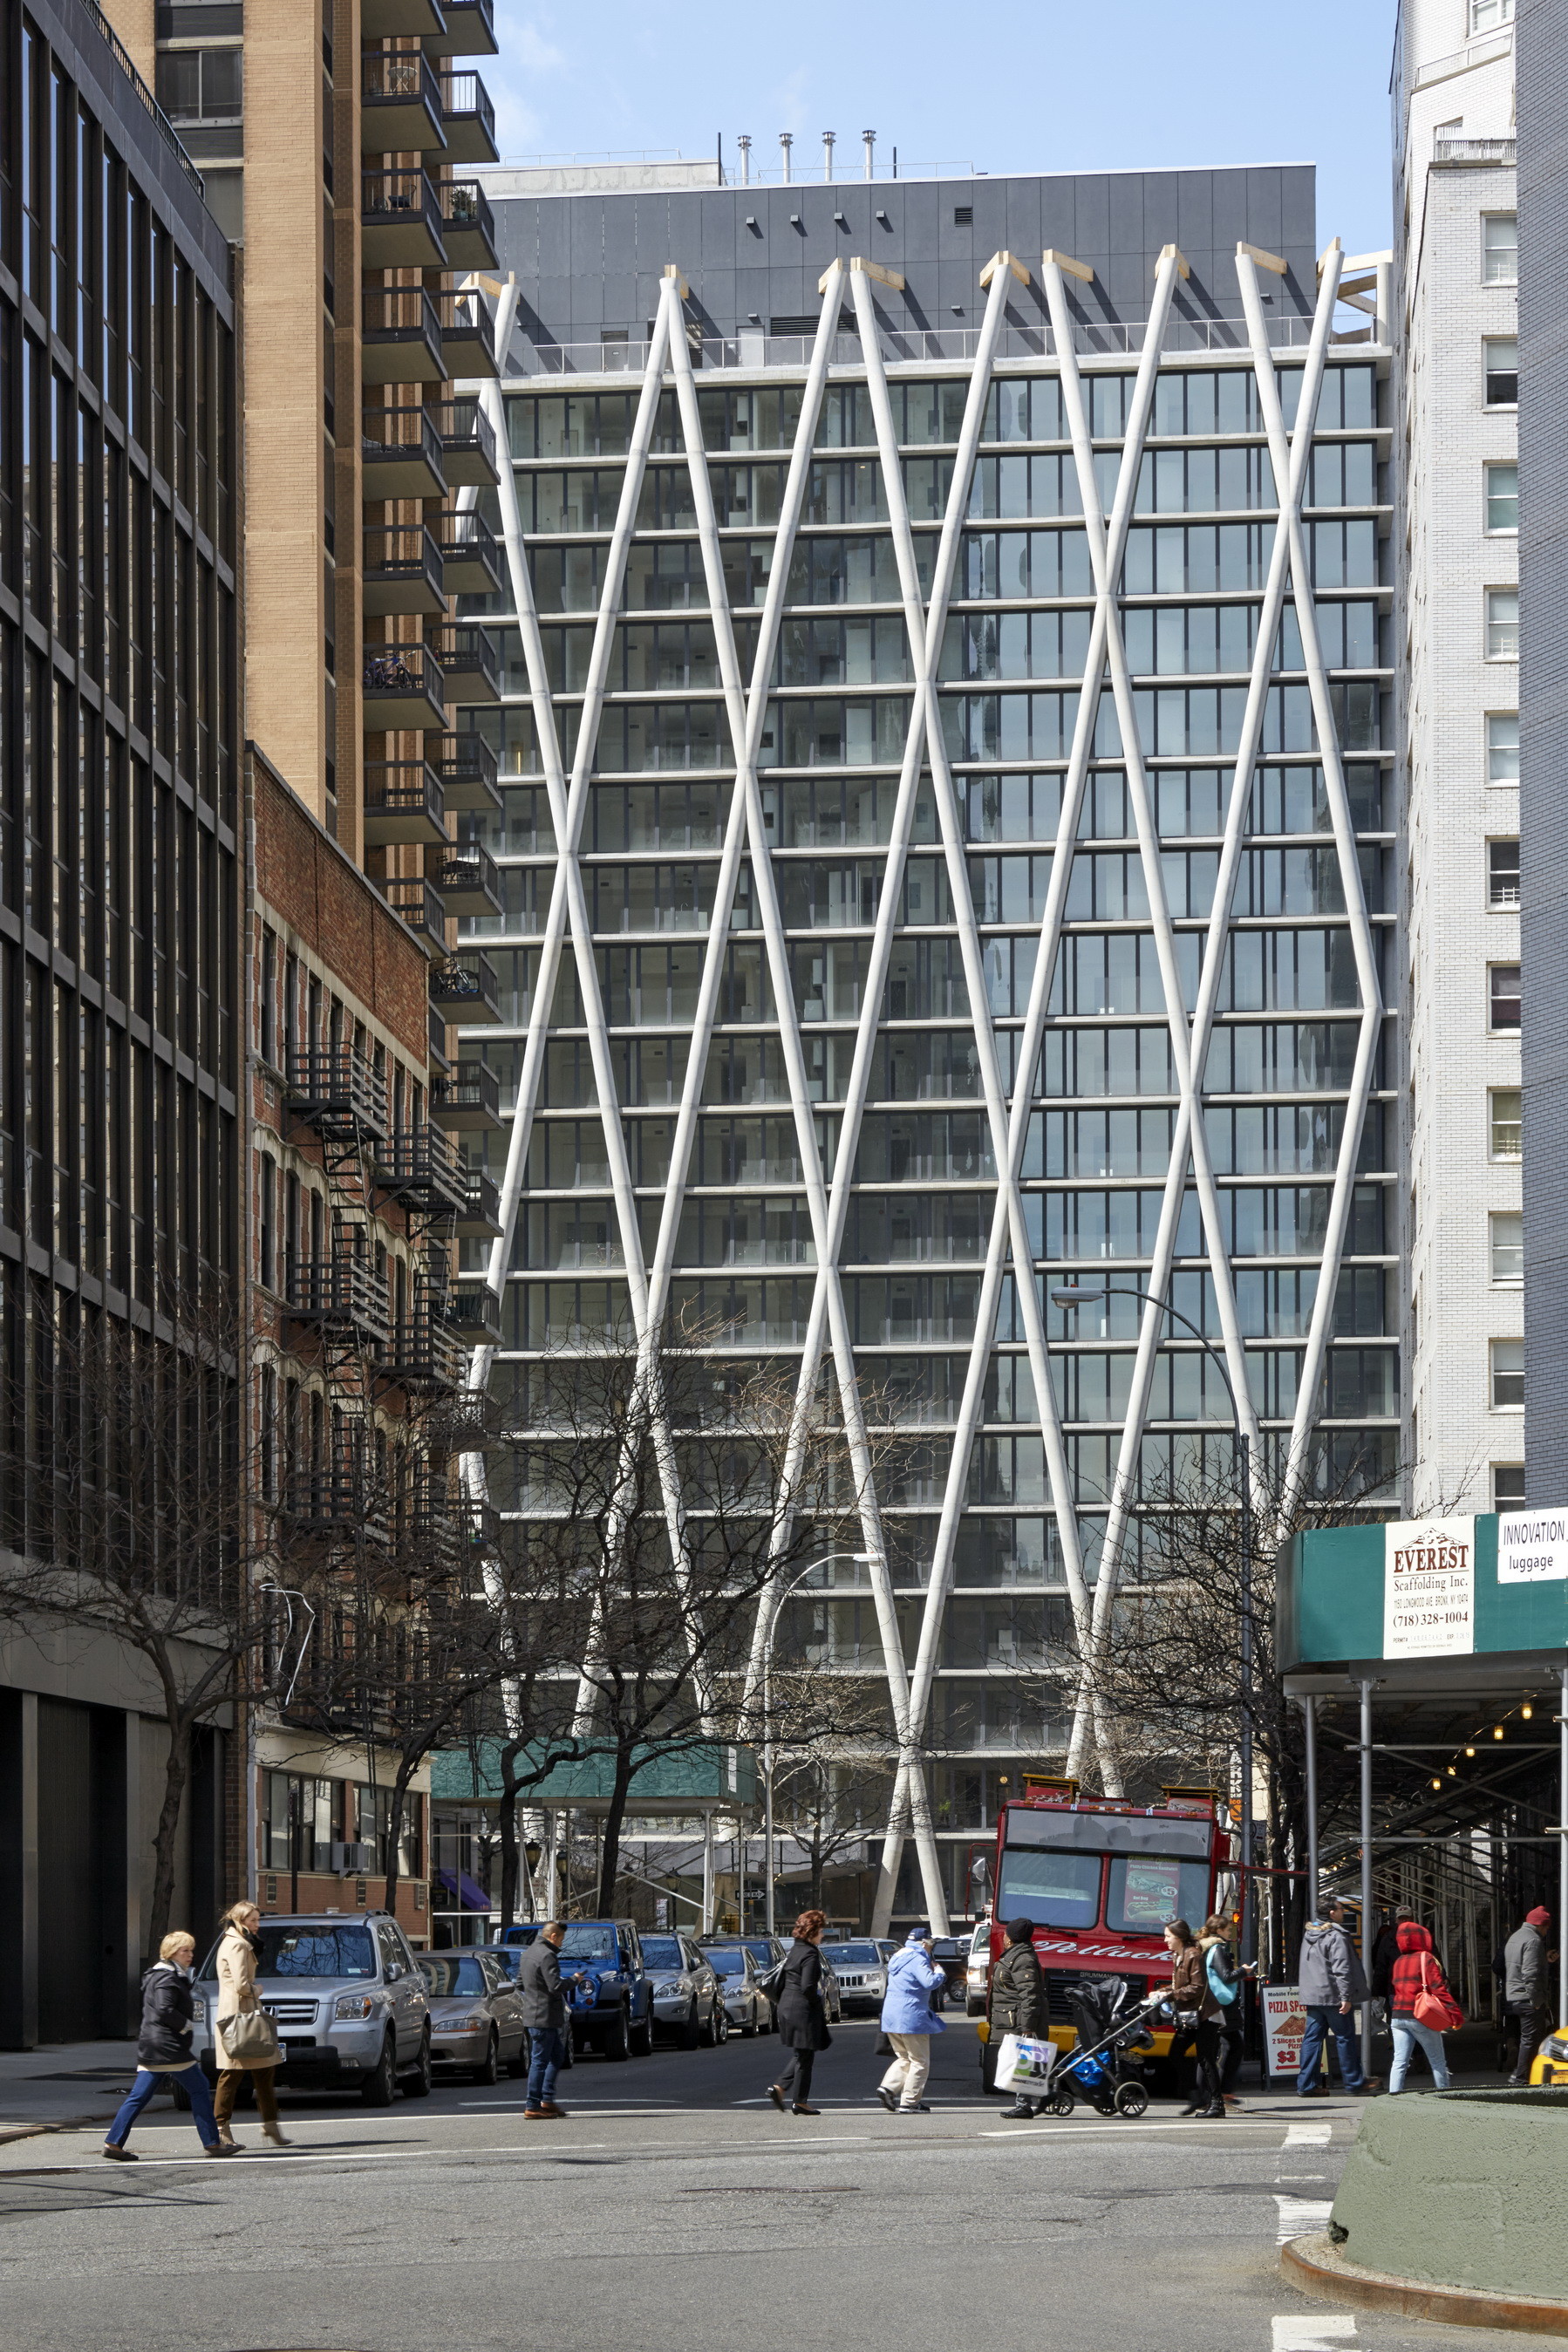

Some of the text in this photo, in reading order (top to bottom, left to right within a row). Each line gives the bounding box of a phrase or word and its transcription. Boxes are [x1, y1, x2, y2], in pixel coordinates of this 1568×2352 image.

[1503, 1520, 1565, 1545] INNOVATION
[1394, 1545, 1469, 1573] EVEREST
[1510, 1555, 1553, 1572] luggage
[1394, 1575, 1468, 1592] Scaffolding Inc.
[1450, 1594, 1456, 1605] NY
[1393, 1611, 1469, 1628] (718) 328-1004
[1033, 1940, 1174, 1961] Potluck
[1268, 2001, 1288, 2013] PIZZA
[1277, 2050, 1297, 2064] $3
